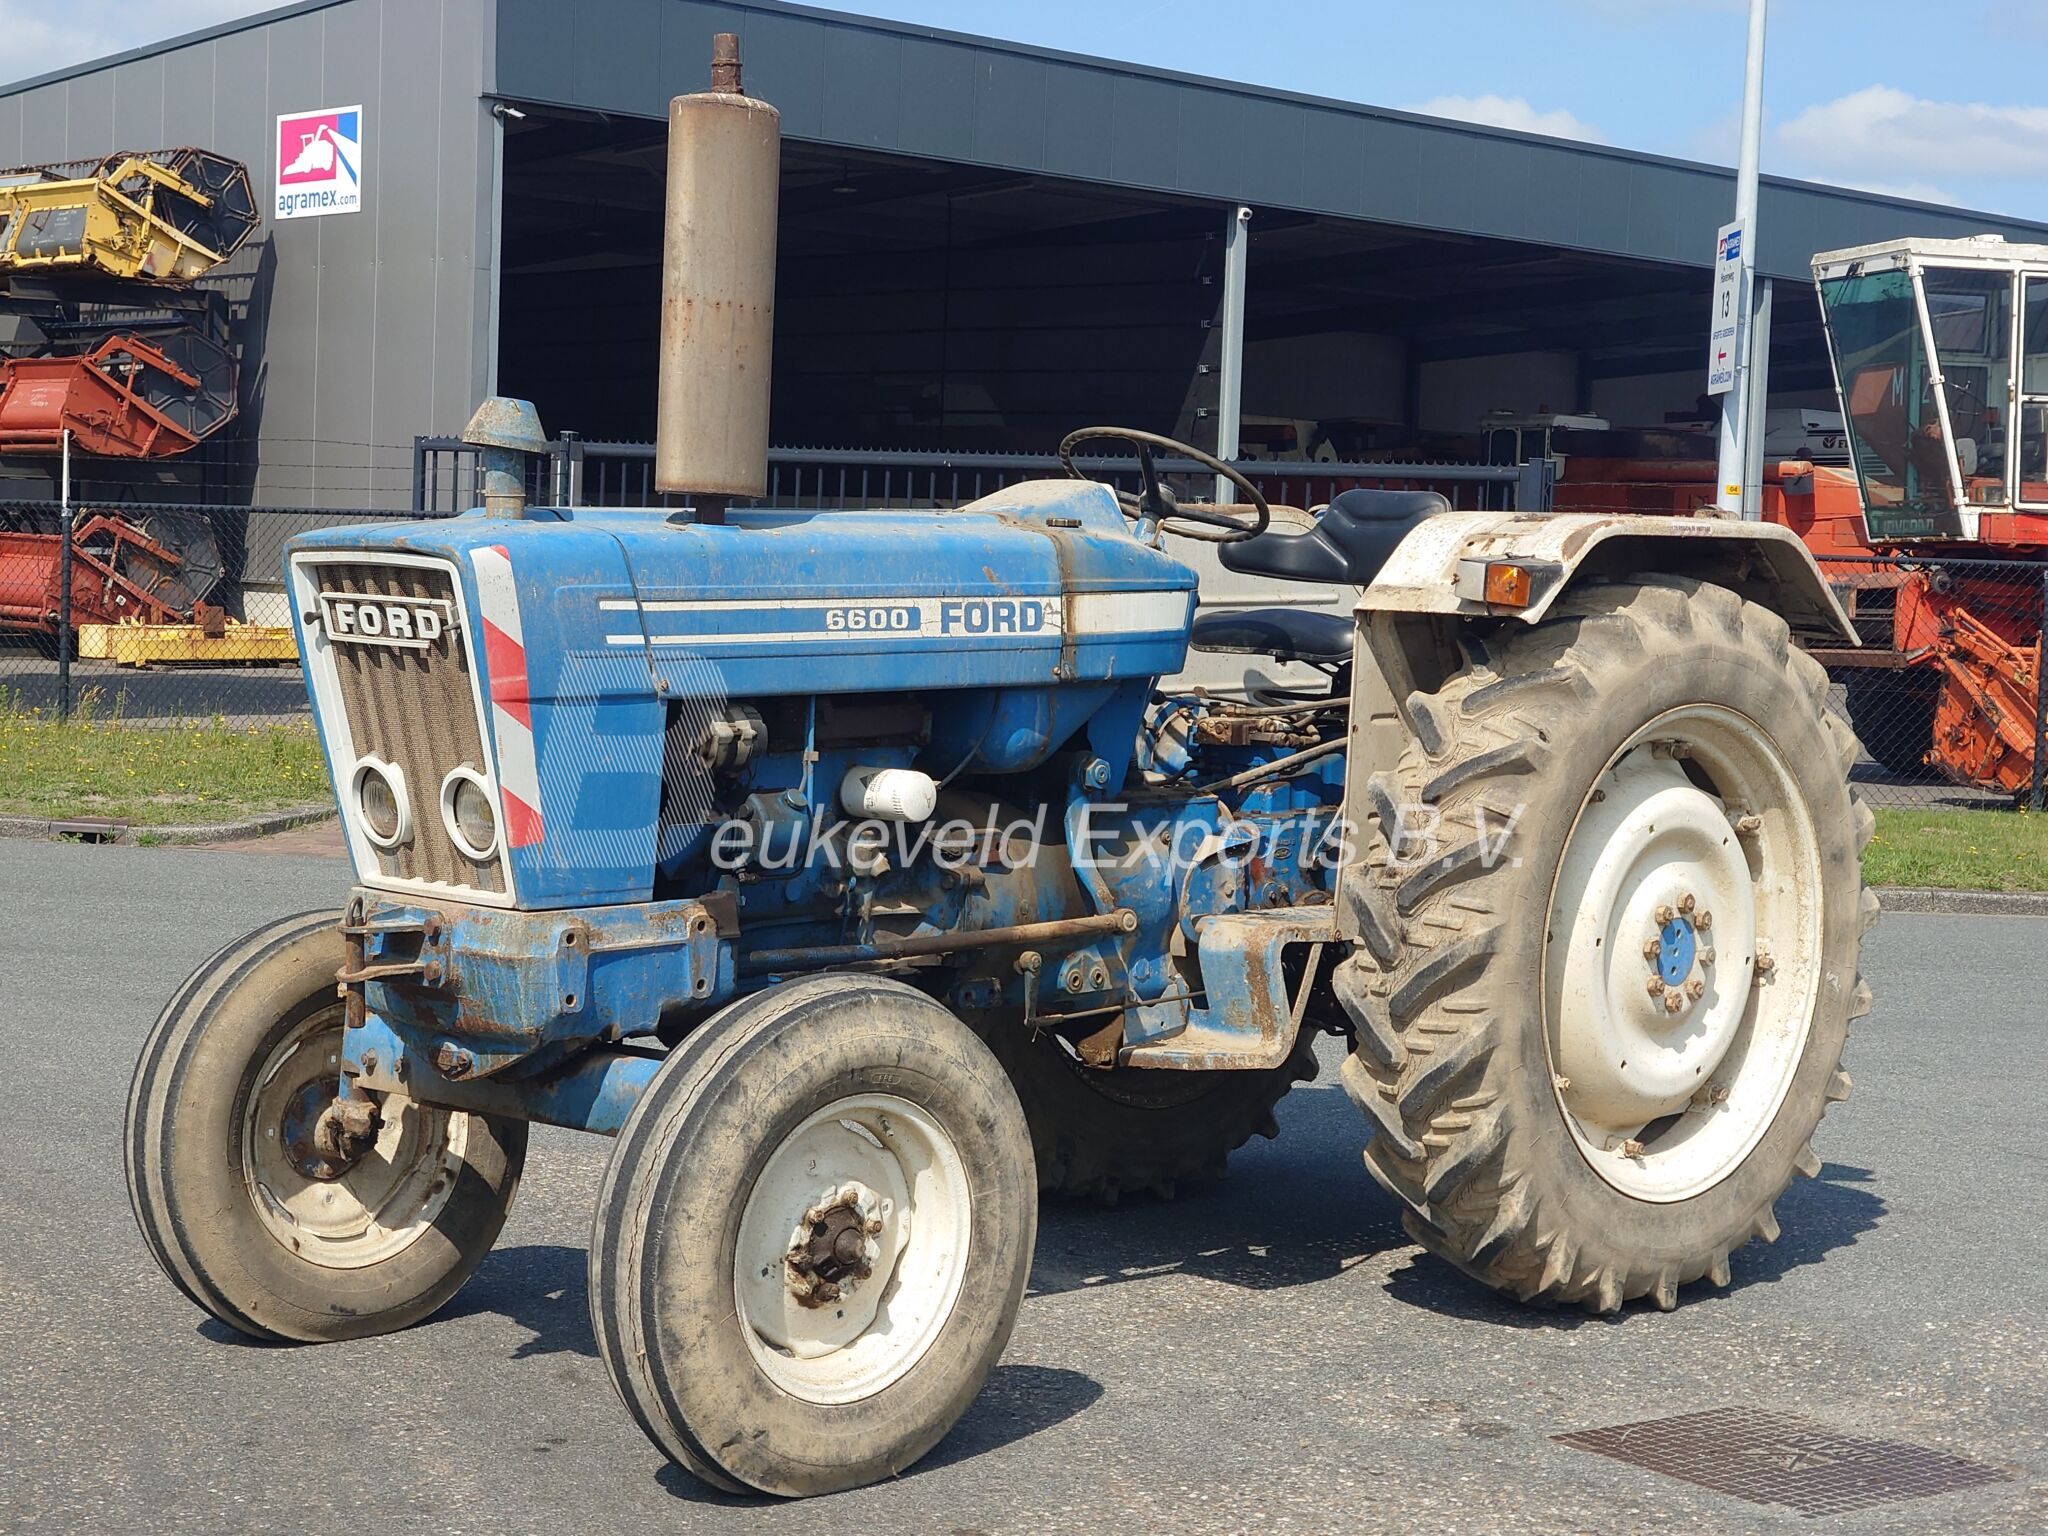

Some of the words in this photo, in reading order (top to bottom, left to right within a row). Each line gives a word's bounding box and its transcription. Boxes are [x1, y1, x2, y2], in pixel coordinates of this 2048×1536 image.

[278, 190, 357, 215] agramex.com
[1722, 290, 1730, 319] 13
[335, 603, 441, 639] FORD
[826, 608, 909, 630] 6600
[940, 600, 1043, 634] FORD
